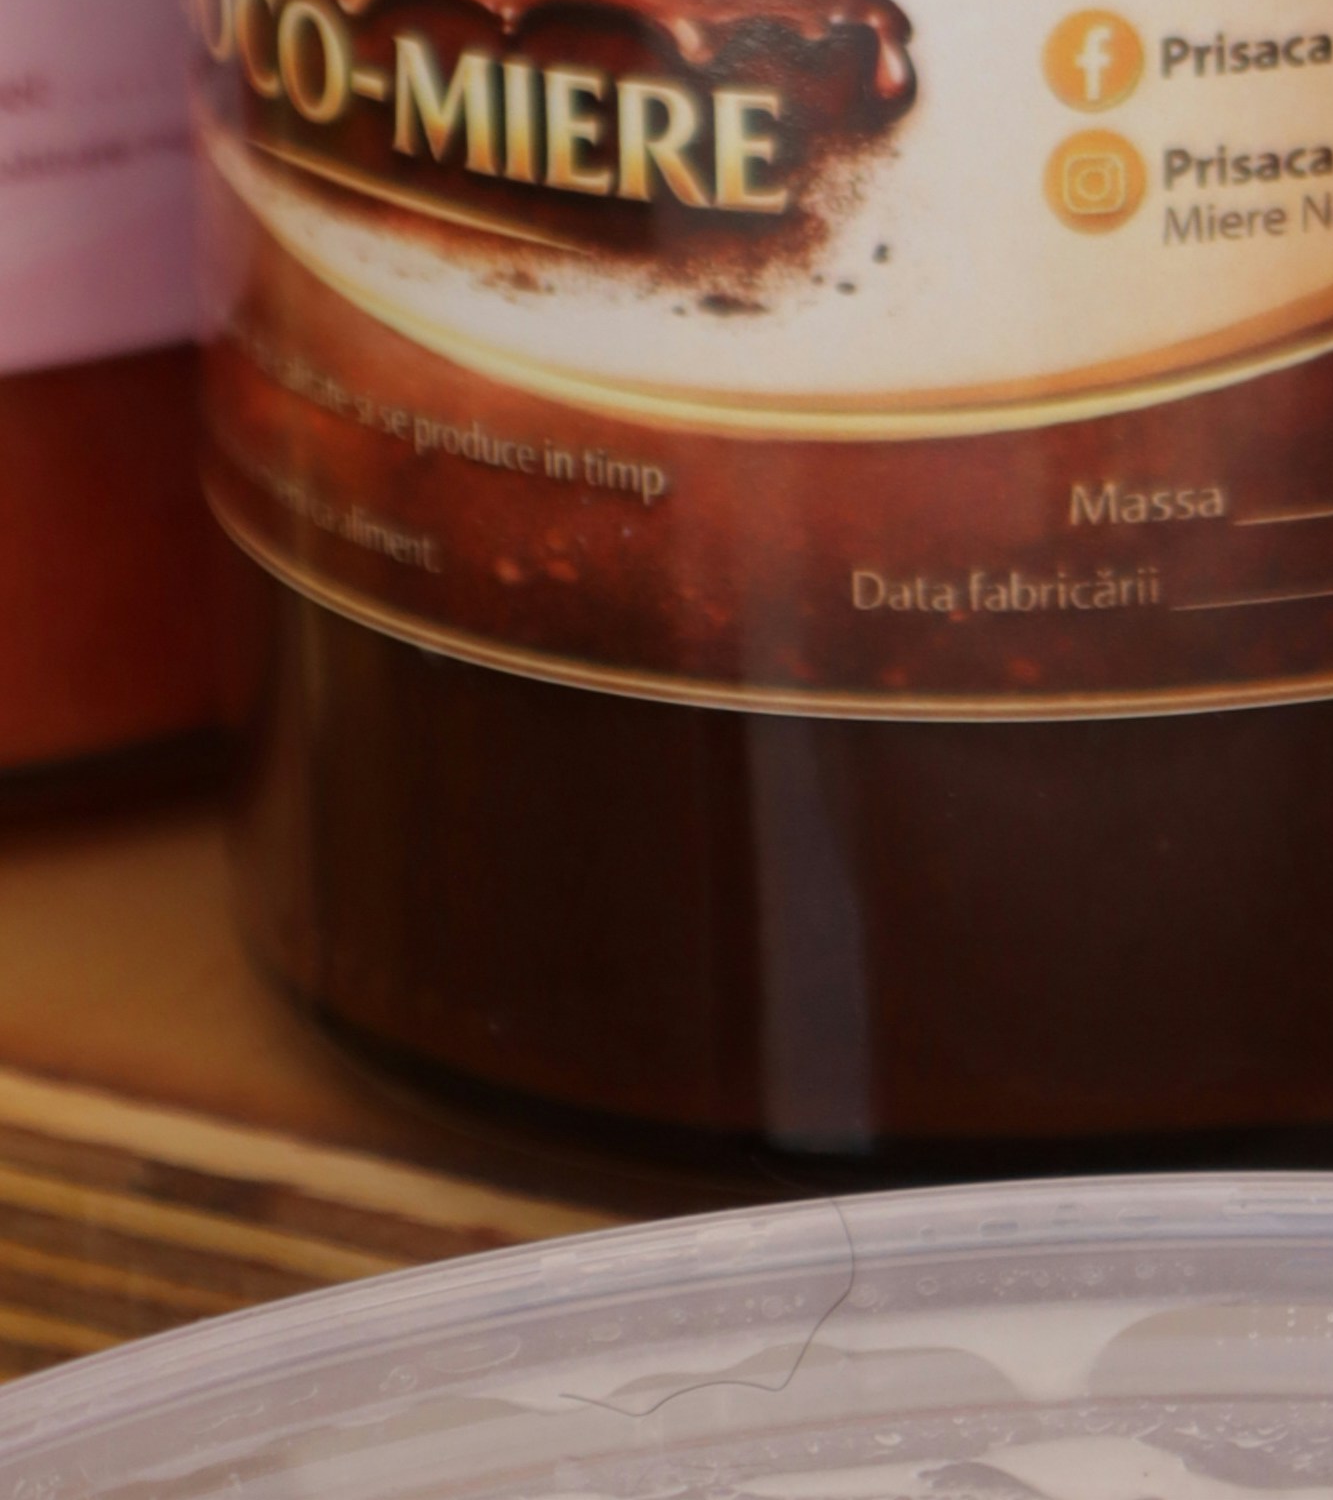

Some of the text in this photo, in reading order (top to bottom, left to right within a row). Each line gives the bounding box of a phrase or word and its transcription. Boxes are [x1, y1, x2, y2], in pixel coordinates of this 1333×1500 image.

[1160, 31, 1333, 80] Prisaca
[1162, 200, 1288, 248] Miere
[413, 420, 538, 475] produce
[583, 448, 667, 506] timp
[1069, 482, 1227, 527] Massa
[852, 566, 1160, 613] Data fabricării
